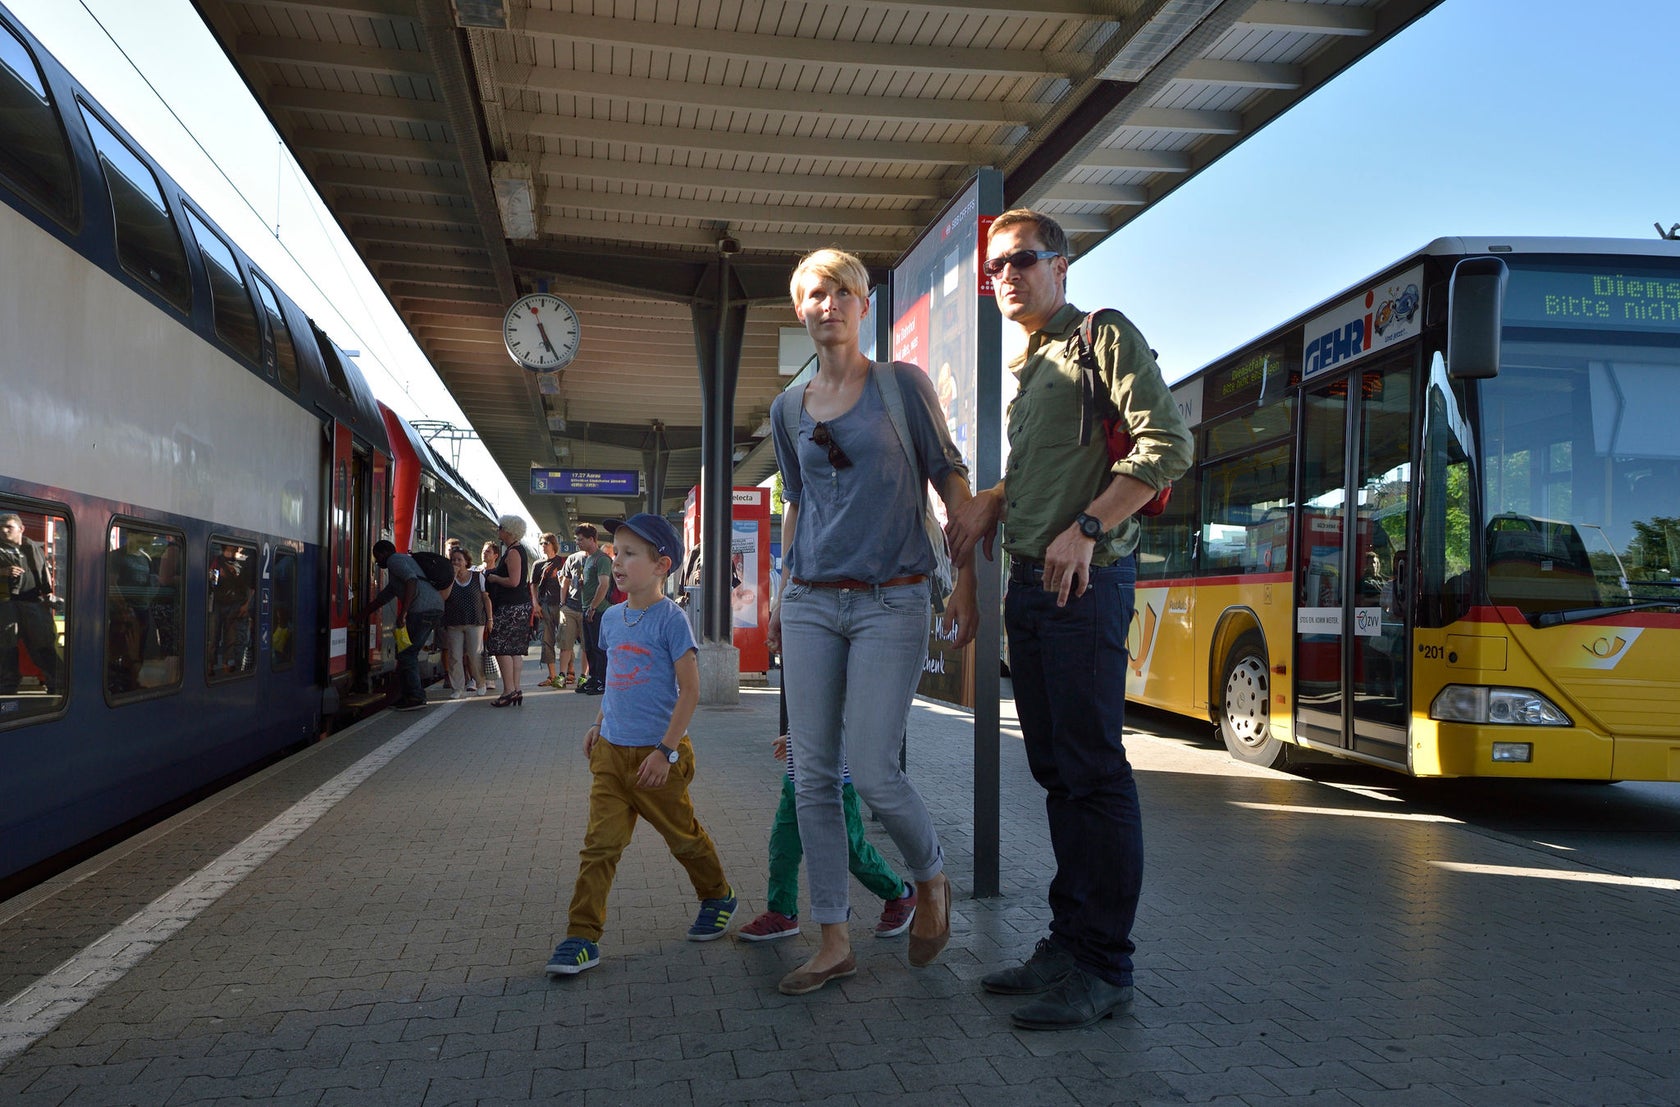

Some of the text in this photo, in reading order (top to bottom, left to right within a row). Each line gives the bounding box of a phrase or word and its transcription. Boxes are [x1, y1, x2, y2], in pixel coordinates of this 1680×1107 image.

[1545, 295, 1610, 318] Bitte
[538, 481, 545, 489] 3
[731, 494, 754, 502] electa
[564, 544, 570, 552] 3
[262, 541, 270, 580] 2
[1367, 616, 1379, 627] ZVV
[1424, 645, 1445, 659] 201
